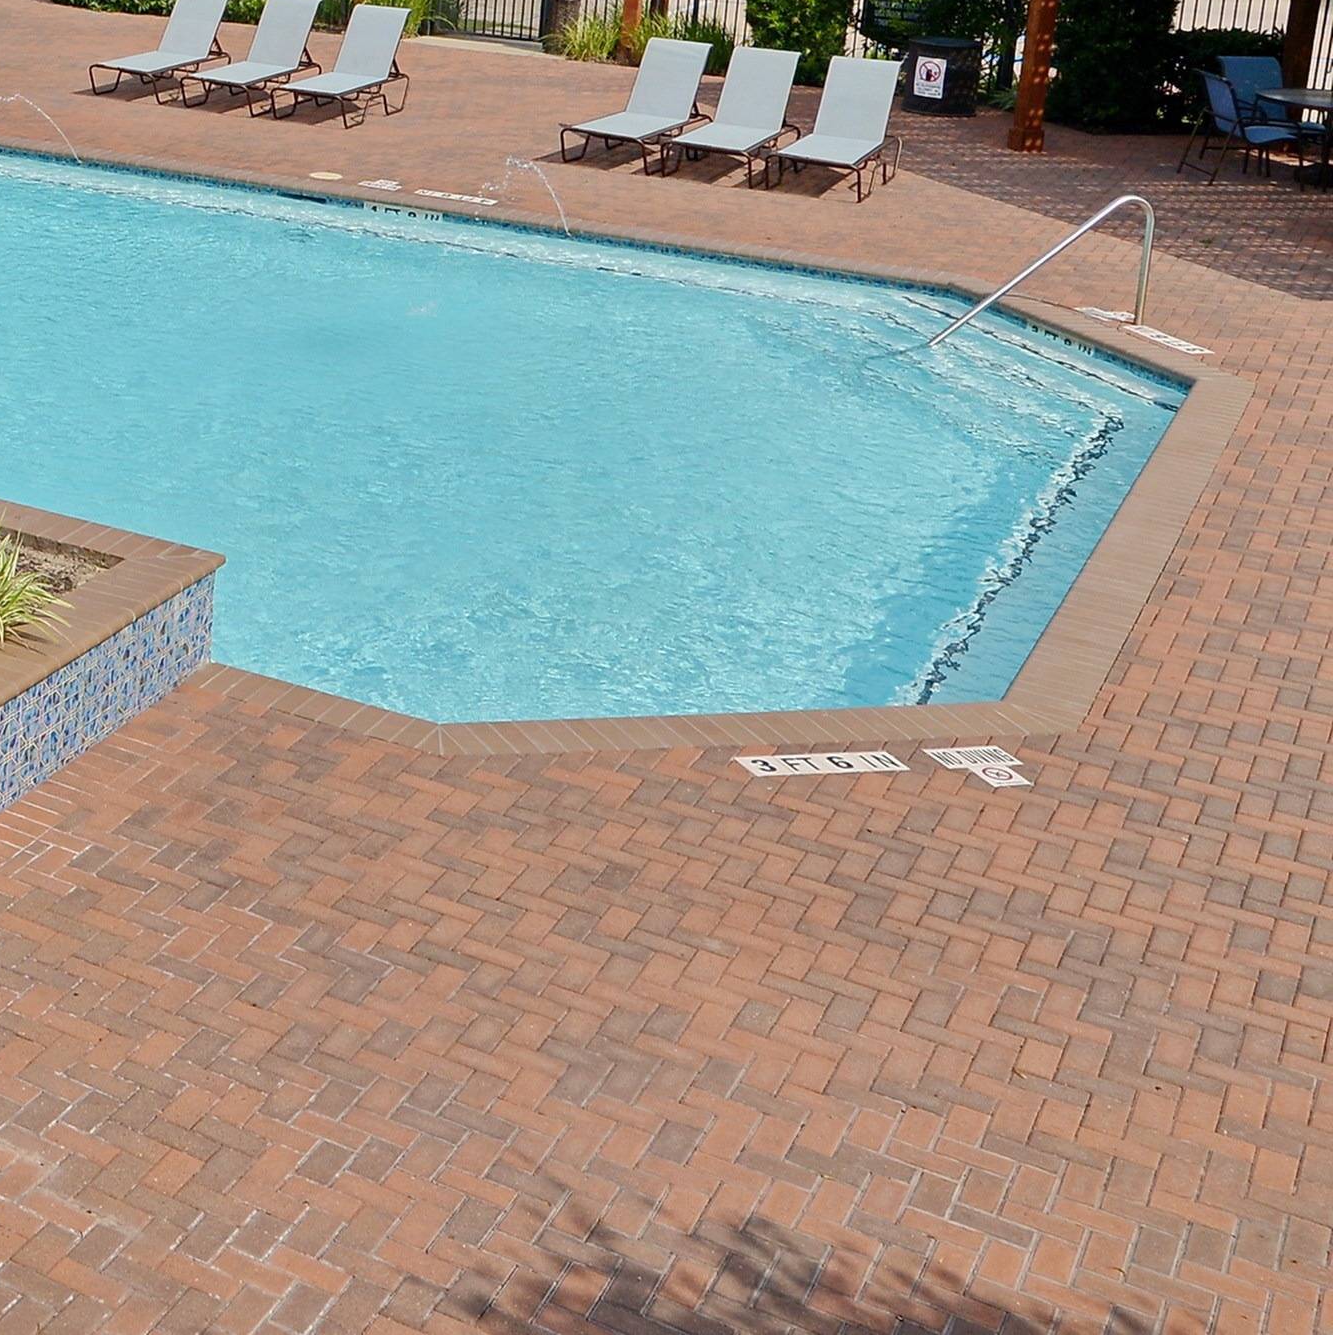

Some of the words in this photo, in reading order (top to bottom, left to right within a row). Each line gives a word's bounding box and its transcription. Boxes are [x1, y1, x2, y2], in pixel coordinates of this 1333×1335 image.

[750, 758, 777, 773] 3
[780, 757, 820, 772] FT
[827, 755, 855, 770] 6
[859, 754, 898, 769] IN
[930, 751, 964, 766] NO
[955, 748, 1015, 764] DIVING
